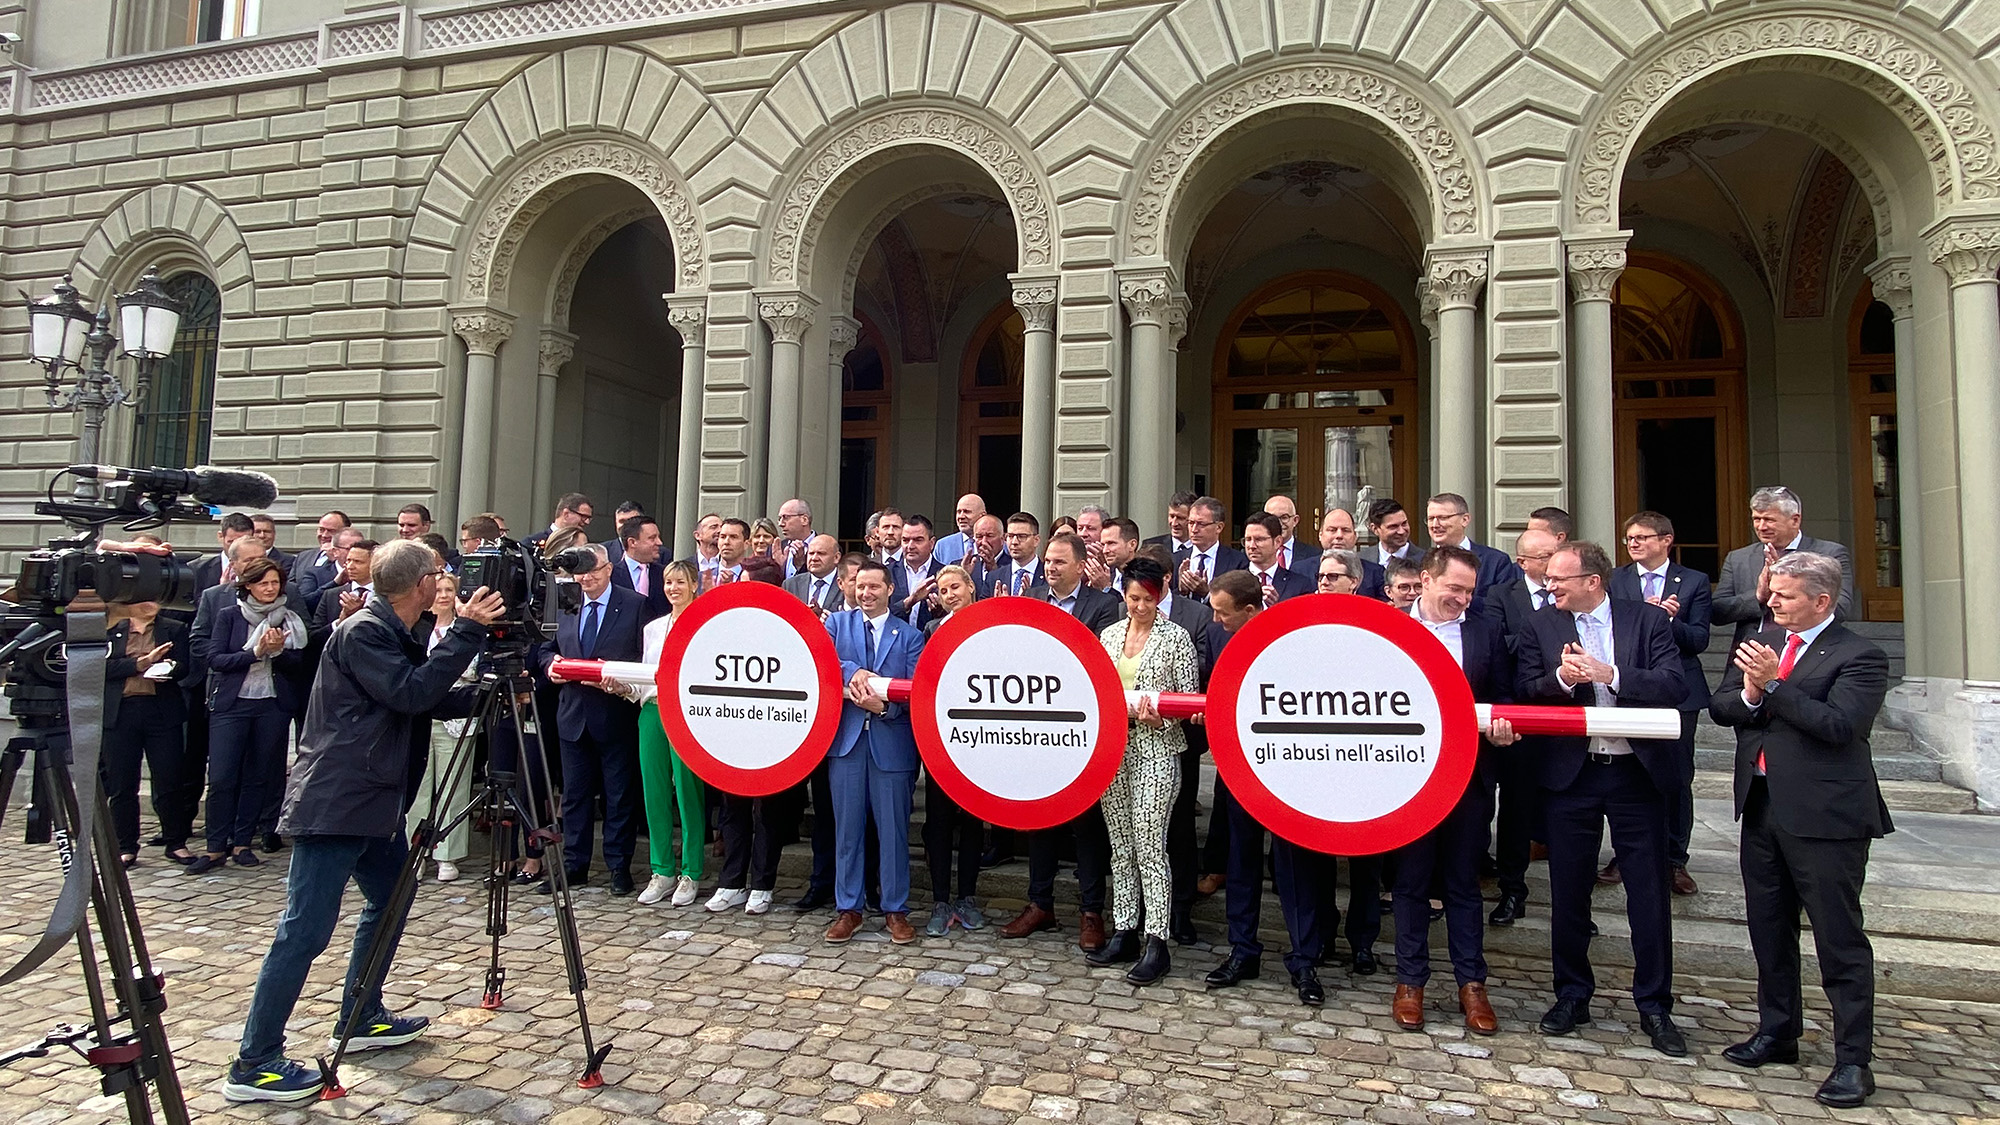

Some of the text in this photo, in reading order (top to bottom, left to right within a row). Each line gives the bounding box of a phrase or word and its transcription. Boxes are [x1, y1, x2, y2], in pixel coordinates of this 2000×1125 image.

[715, 654, 781, 684] STOP
[967, 674, 1062, 705] STOPP
[1259, 683, 1411, 717] Fermare
[688, 705, 712, 717] aux
[715, 703, 745, 719] abus
[747, 705, 763, 721] de
[949, 725, 1087, 749] Asylmissbrauch!
[1255, 742, 1276, 765] gli
[1282, 742, 1330, 761] abusi
